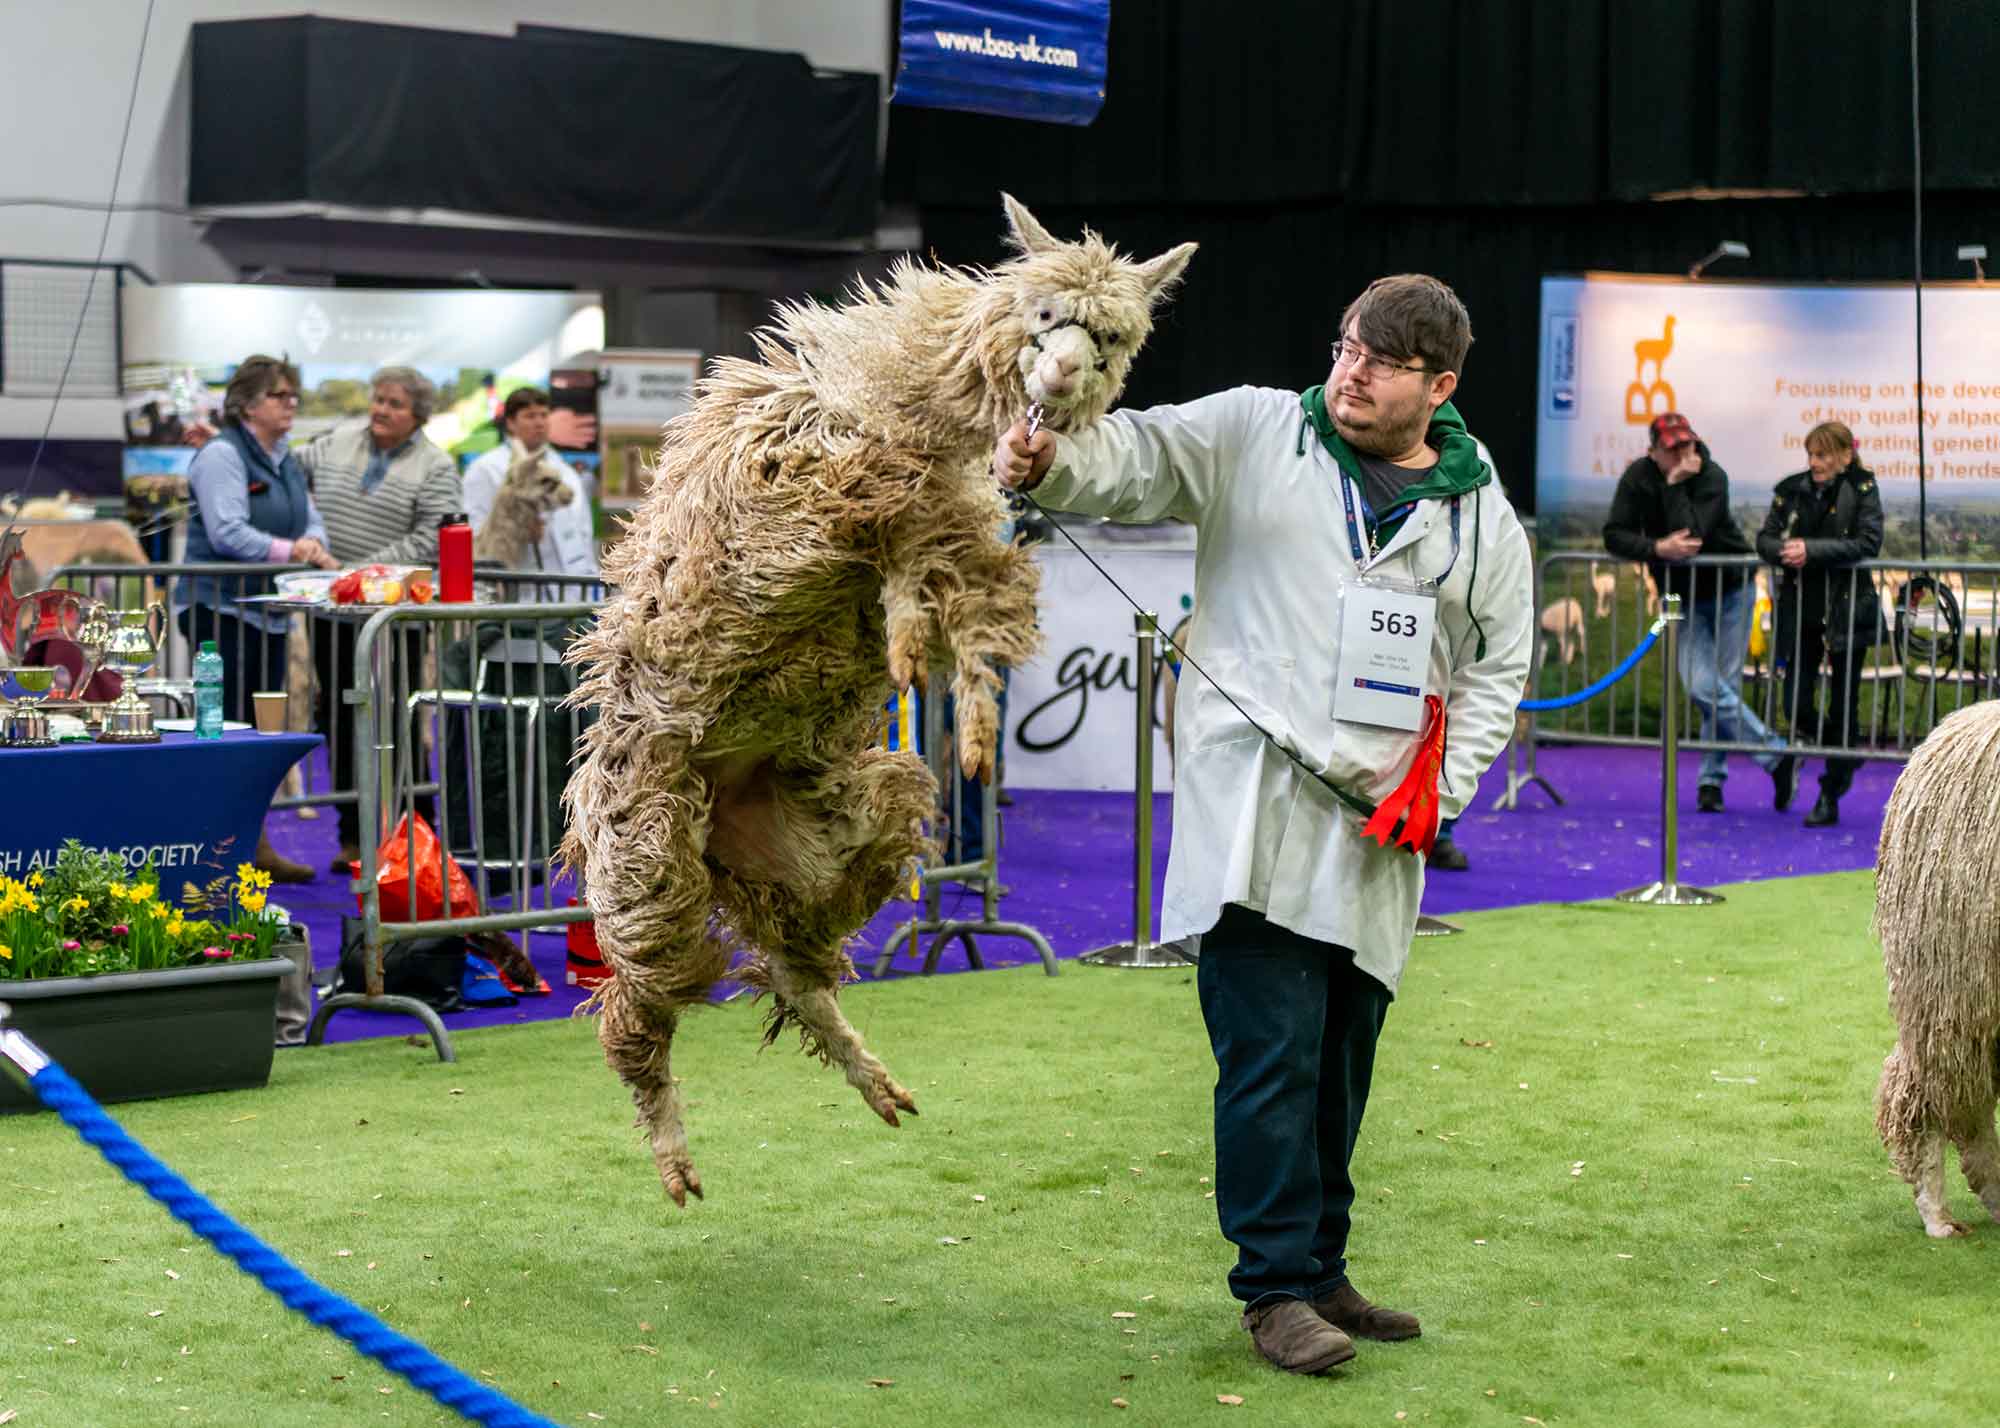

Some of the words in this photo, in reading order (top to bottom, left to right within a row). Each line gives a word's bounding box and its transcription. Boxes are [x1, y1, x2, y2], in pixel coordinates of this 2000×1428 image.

[934, 27, 1078, 68] www.bas-uk.com
[1775, 377, 1872, 402] Focusing
[1879, 383, 1905, 398] on
[1801, 404, 1822, 424] of
[1828, 405, 1861, 427] top
[1868, 405, 1938, 430] qualty
[1942, 459, 2000, 479] herds
[1369, 609, 1418, 638] 563
[27, 846, 111, 871] ALPCA
[119, 842, 205, 868] SOCIETY
